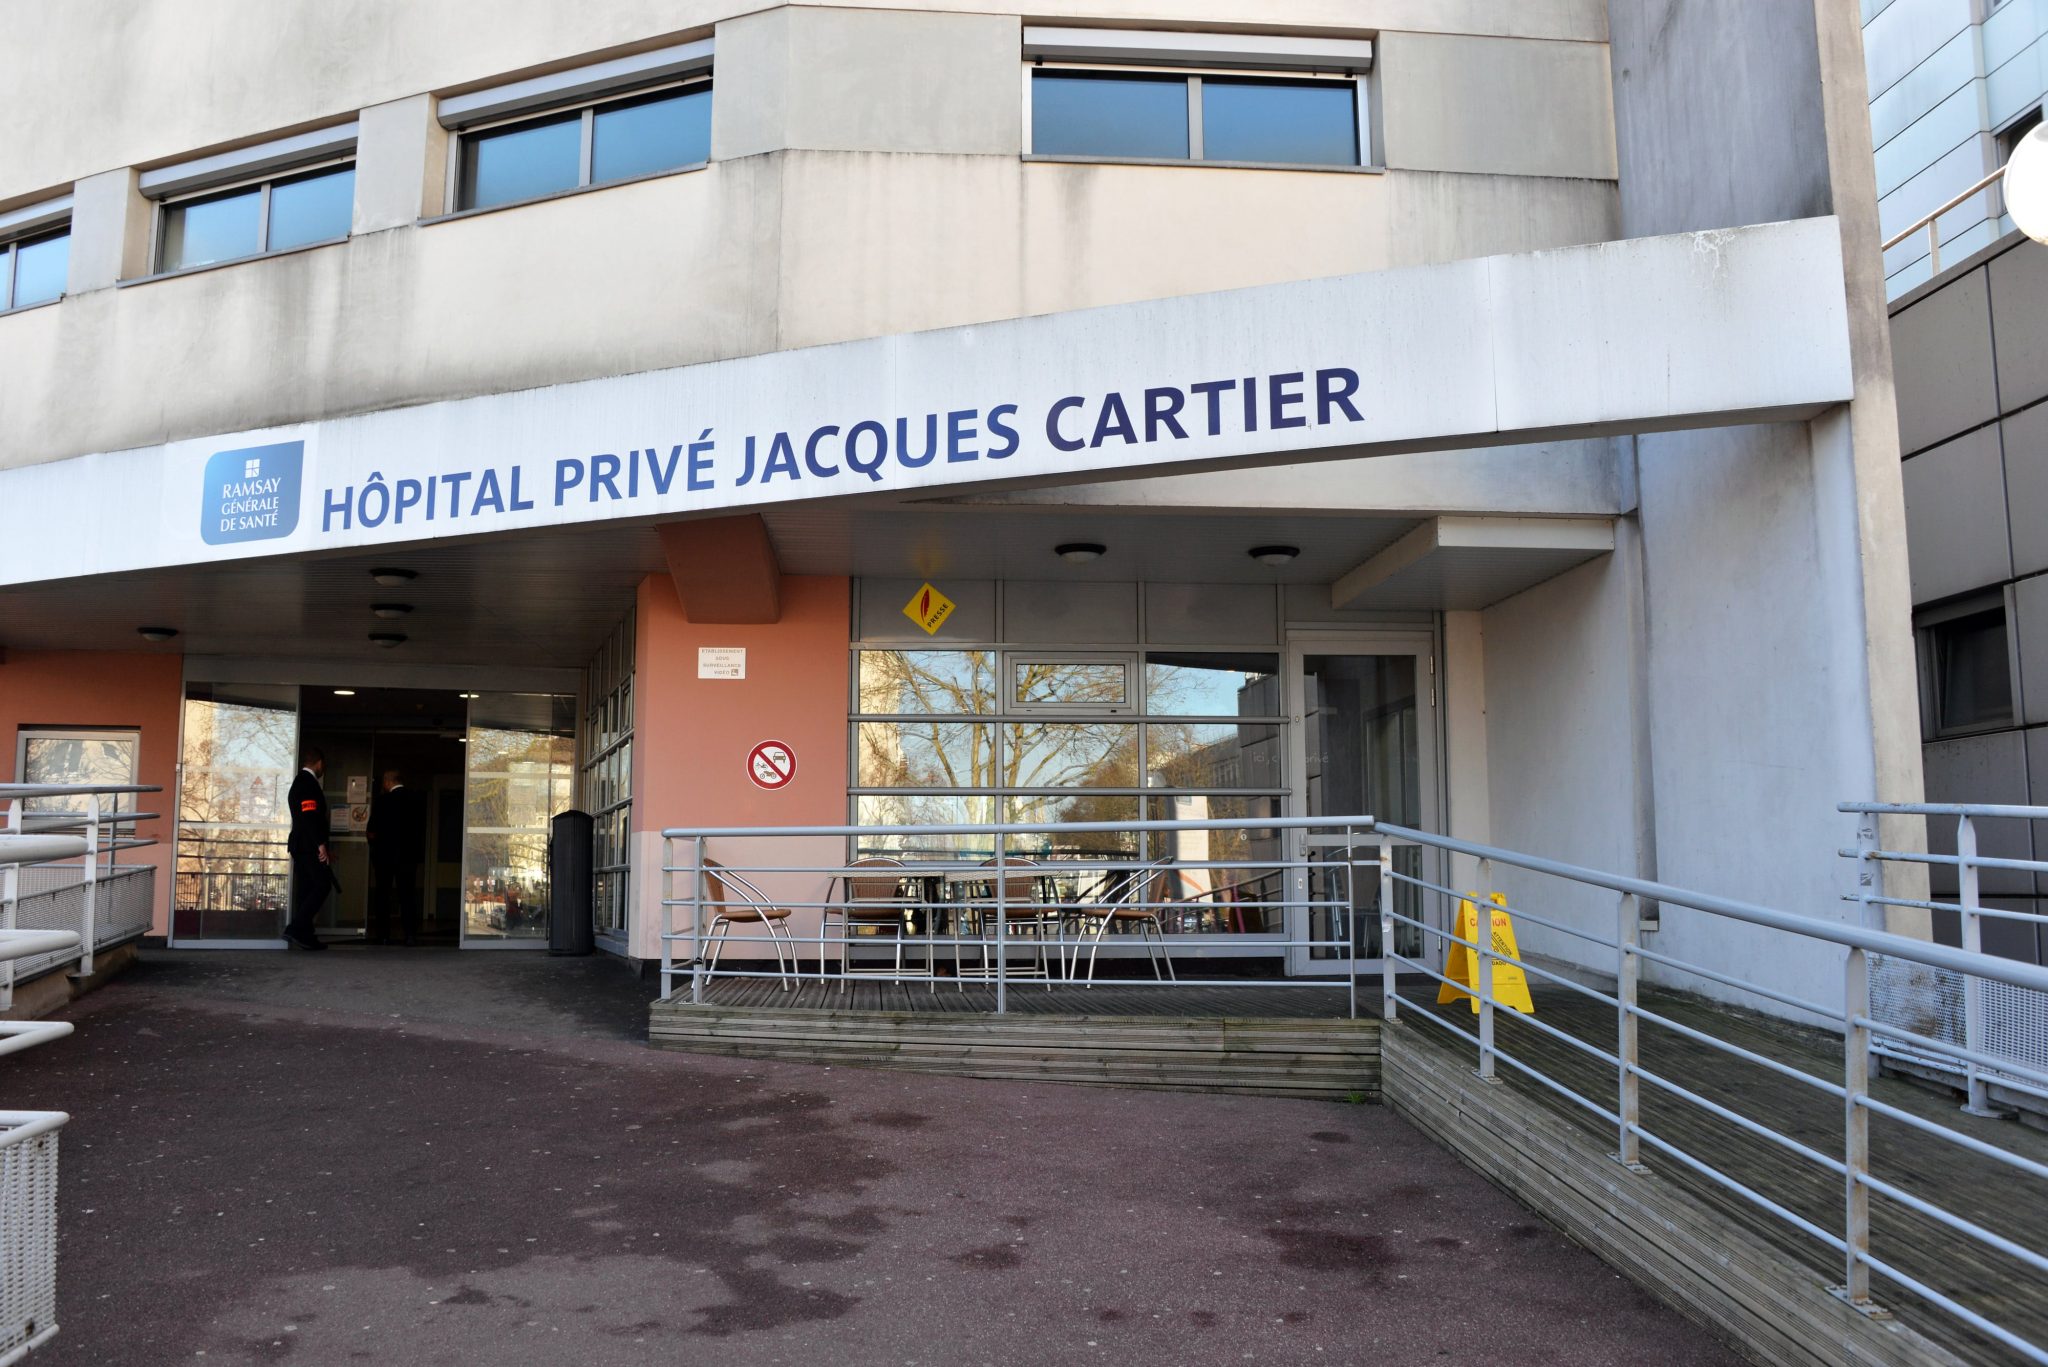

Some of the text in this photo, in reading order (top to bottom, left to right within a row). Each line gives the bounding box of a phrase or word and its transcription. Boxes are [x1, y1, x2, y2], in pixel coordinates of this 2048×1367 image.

[322, 367, 1364, 533] HÔPITAL PRIVÉ JACQUES CARTIER
[222, 477, 282, 499] RAMSAY
[221, 497, 279, 515] GÉNÉRALE
[220, 509, 278, 532] DE SANTÉ
[927, 603, 949, 628] PRESSE
[1469, 918, 1507, 927] CION
